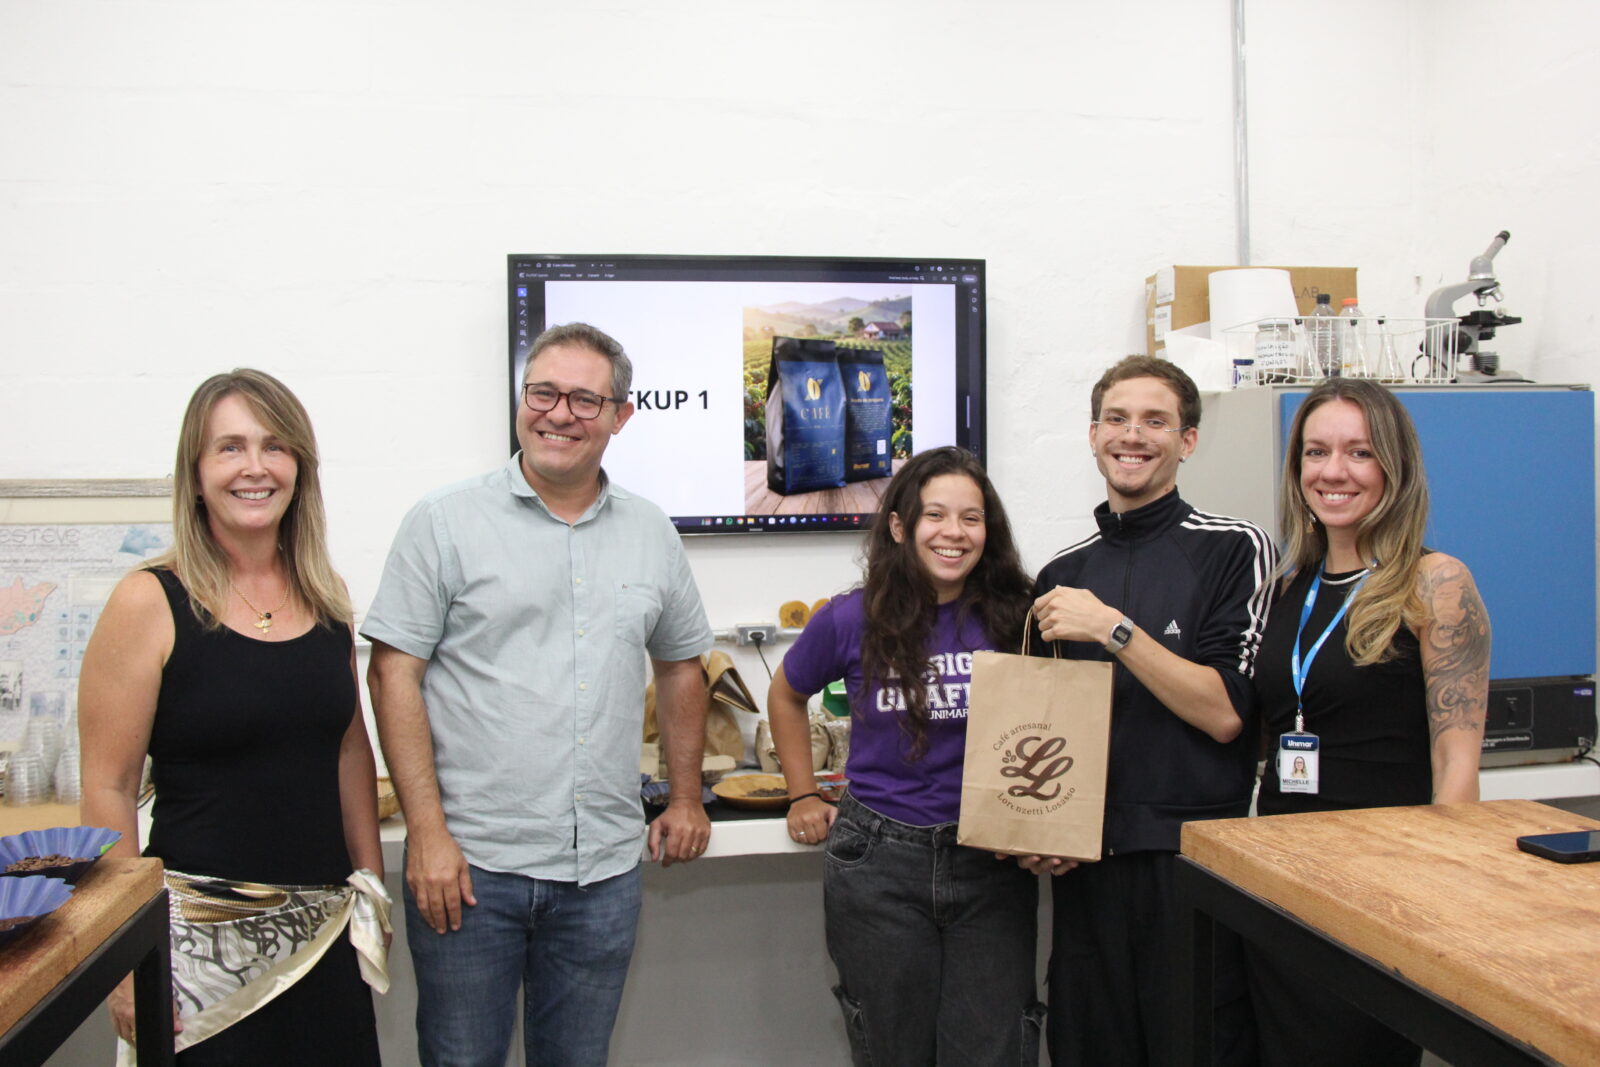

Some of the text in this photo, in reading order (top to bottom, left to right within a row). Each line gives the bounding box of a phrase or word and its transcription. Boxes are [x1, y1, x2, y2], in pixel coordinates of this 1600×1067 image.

[629, 390, 708, 410] KUP 1
[993, 722, 1052, 751] Café artesanal
[997, 787, 1076, 815] Lorenzetti Losasso
